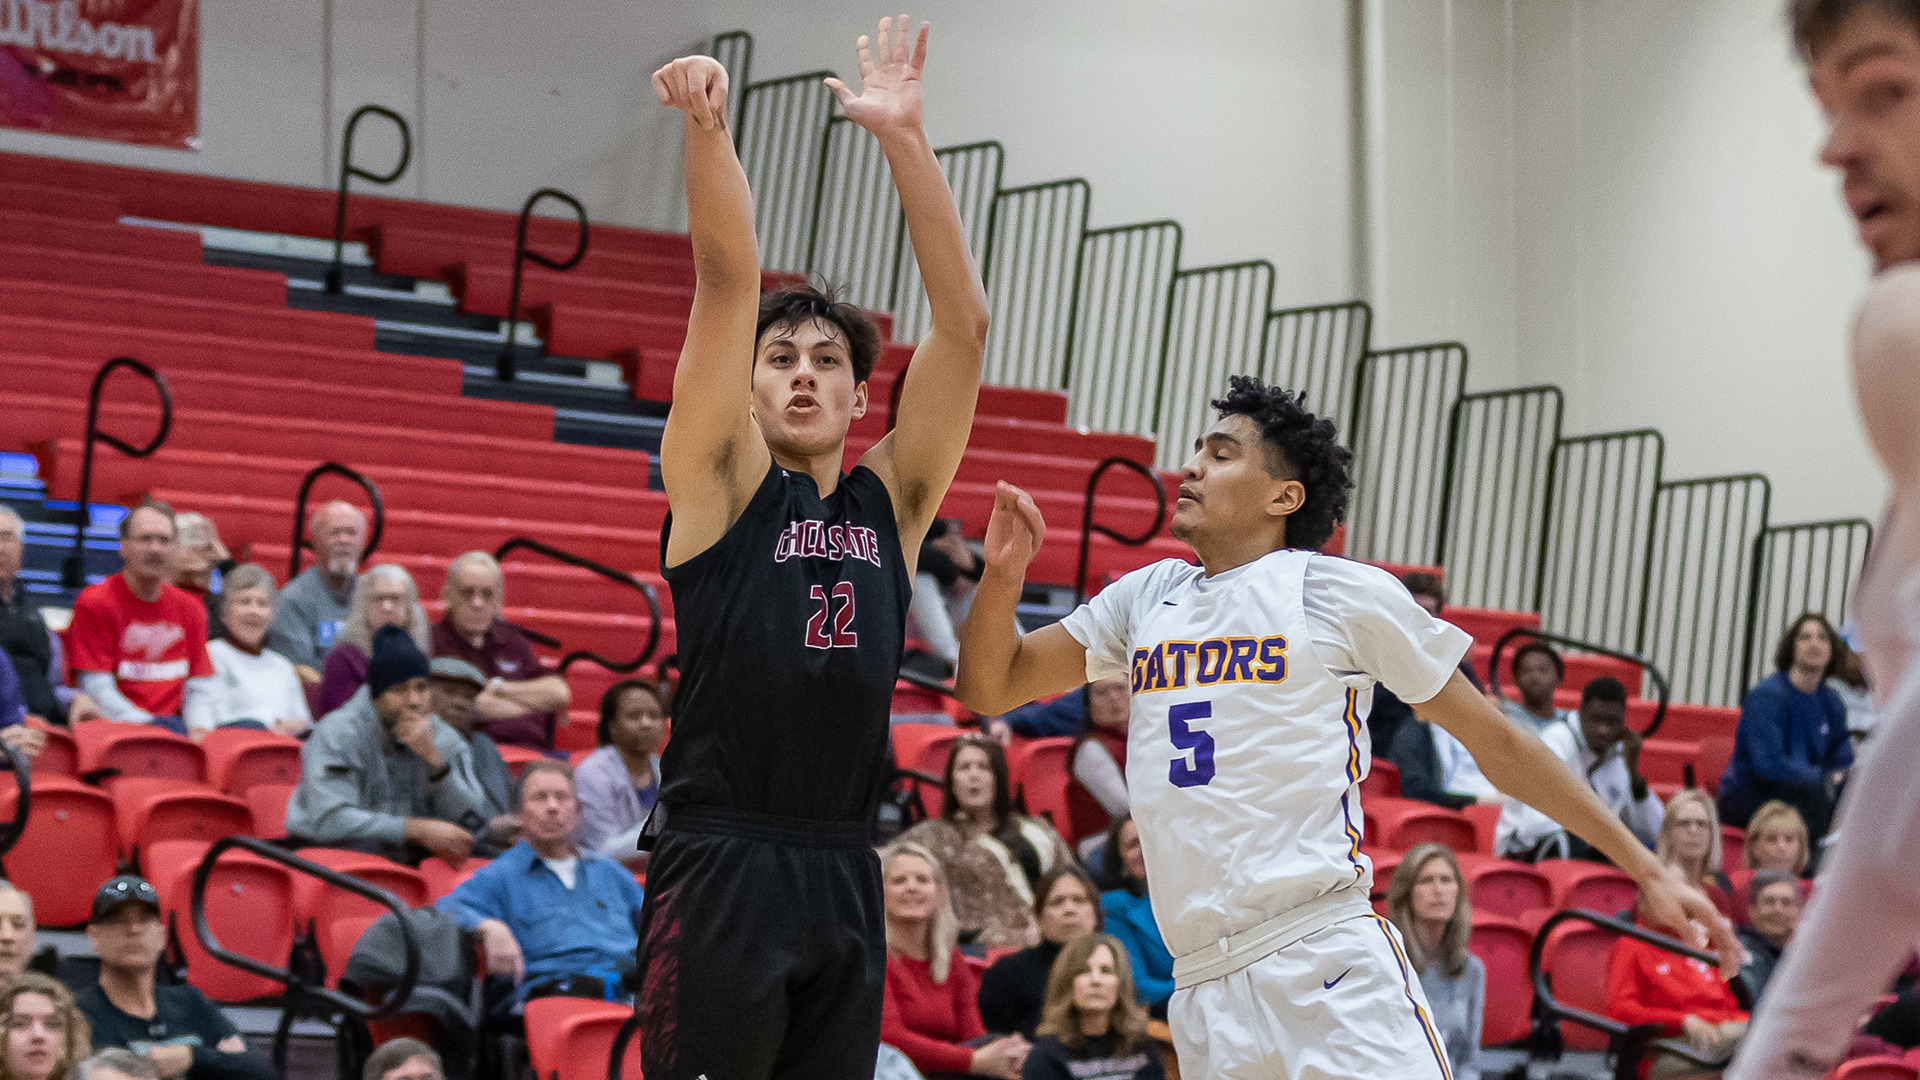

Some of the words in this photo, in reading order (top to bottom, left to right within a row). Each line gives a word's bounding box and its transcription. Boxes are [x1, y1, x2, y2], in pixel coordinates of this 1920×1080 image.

[805, 581, 858, 649] 22
[1131, 634, 1289, 697] GATORS
[1168, 701, 1216, 788] 5
